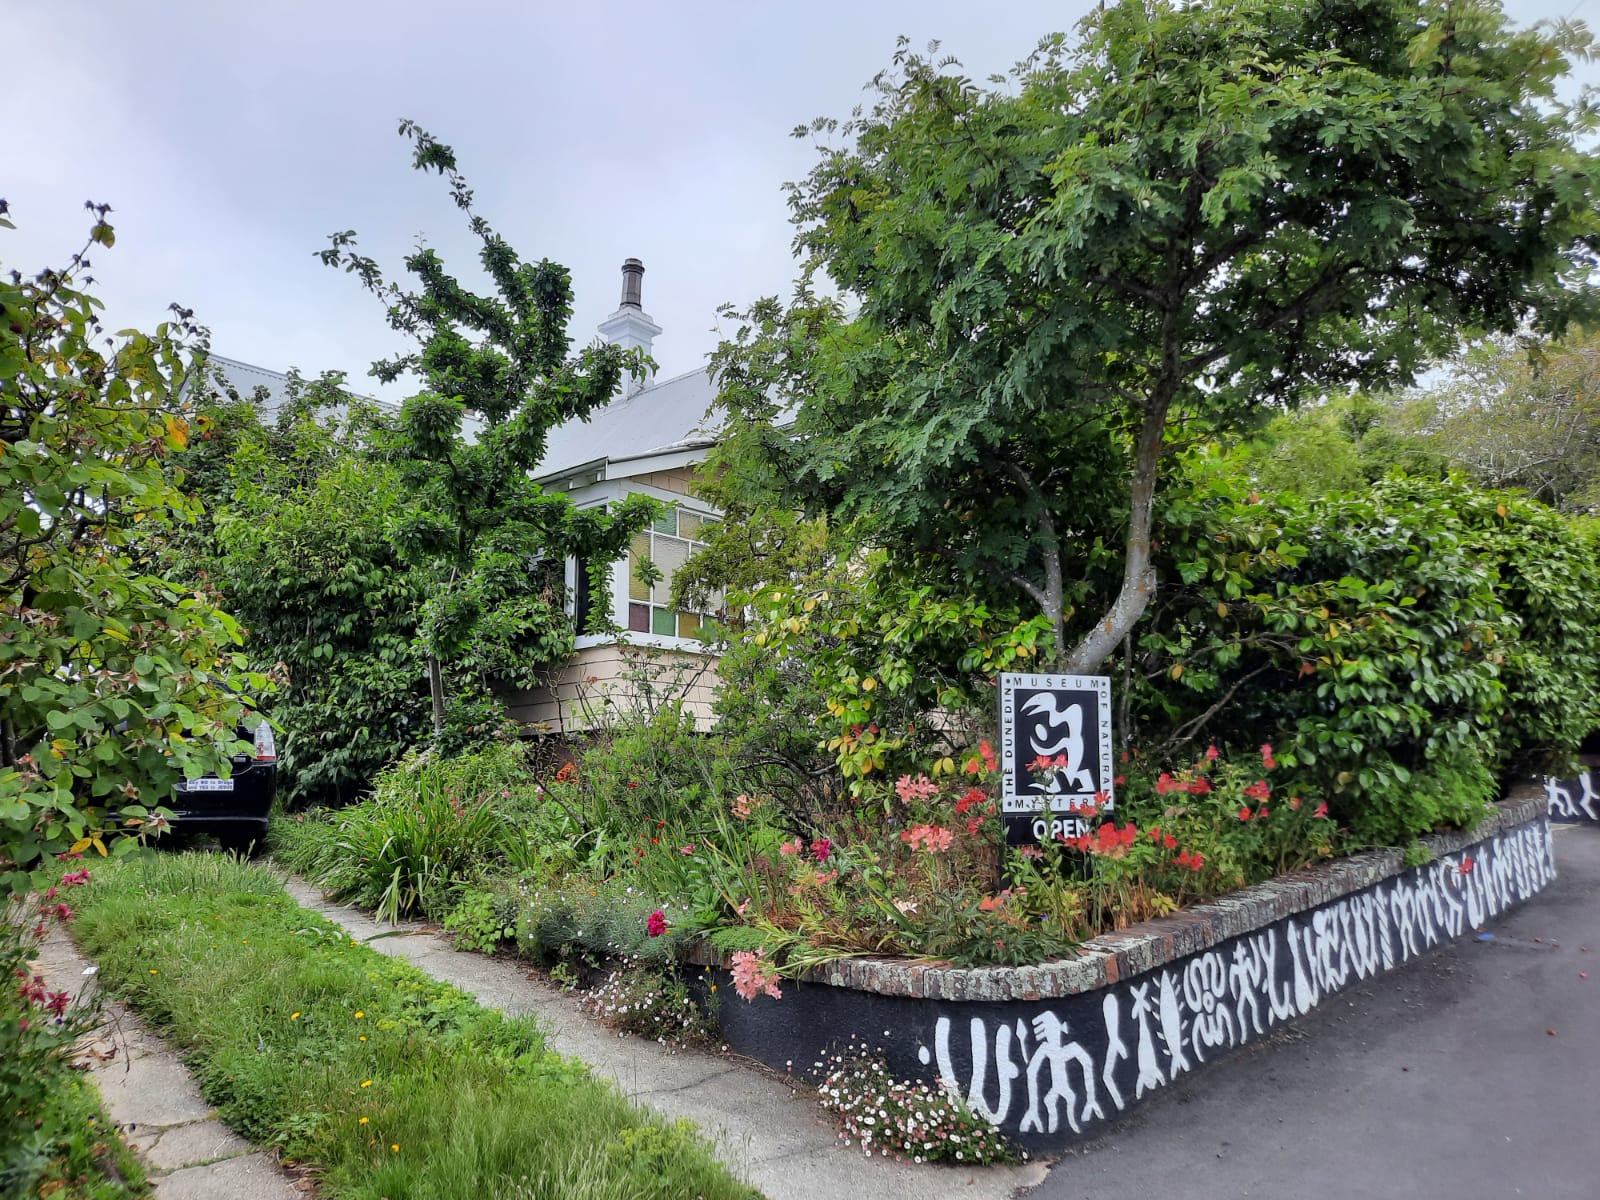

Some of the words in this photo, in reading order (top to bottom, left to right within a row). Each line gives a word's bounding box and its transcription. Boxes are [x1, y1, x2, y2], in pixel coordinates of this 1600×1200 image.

[1013, 677, 1099, 689] MUSEUM
[1099, 690, 1108, 710] OF
[1004, 687, 1013, 758] DUNEDIN
[1005, 768, 1014, 797] THE
[1033, 819, 1091, 841] OPEN
